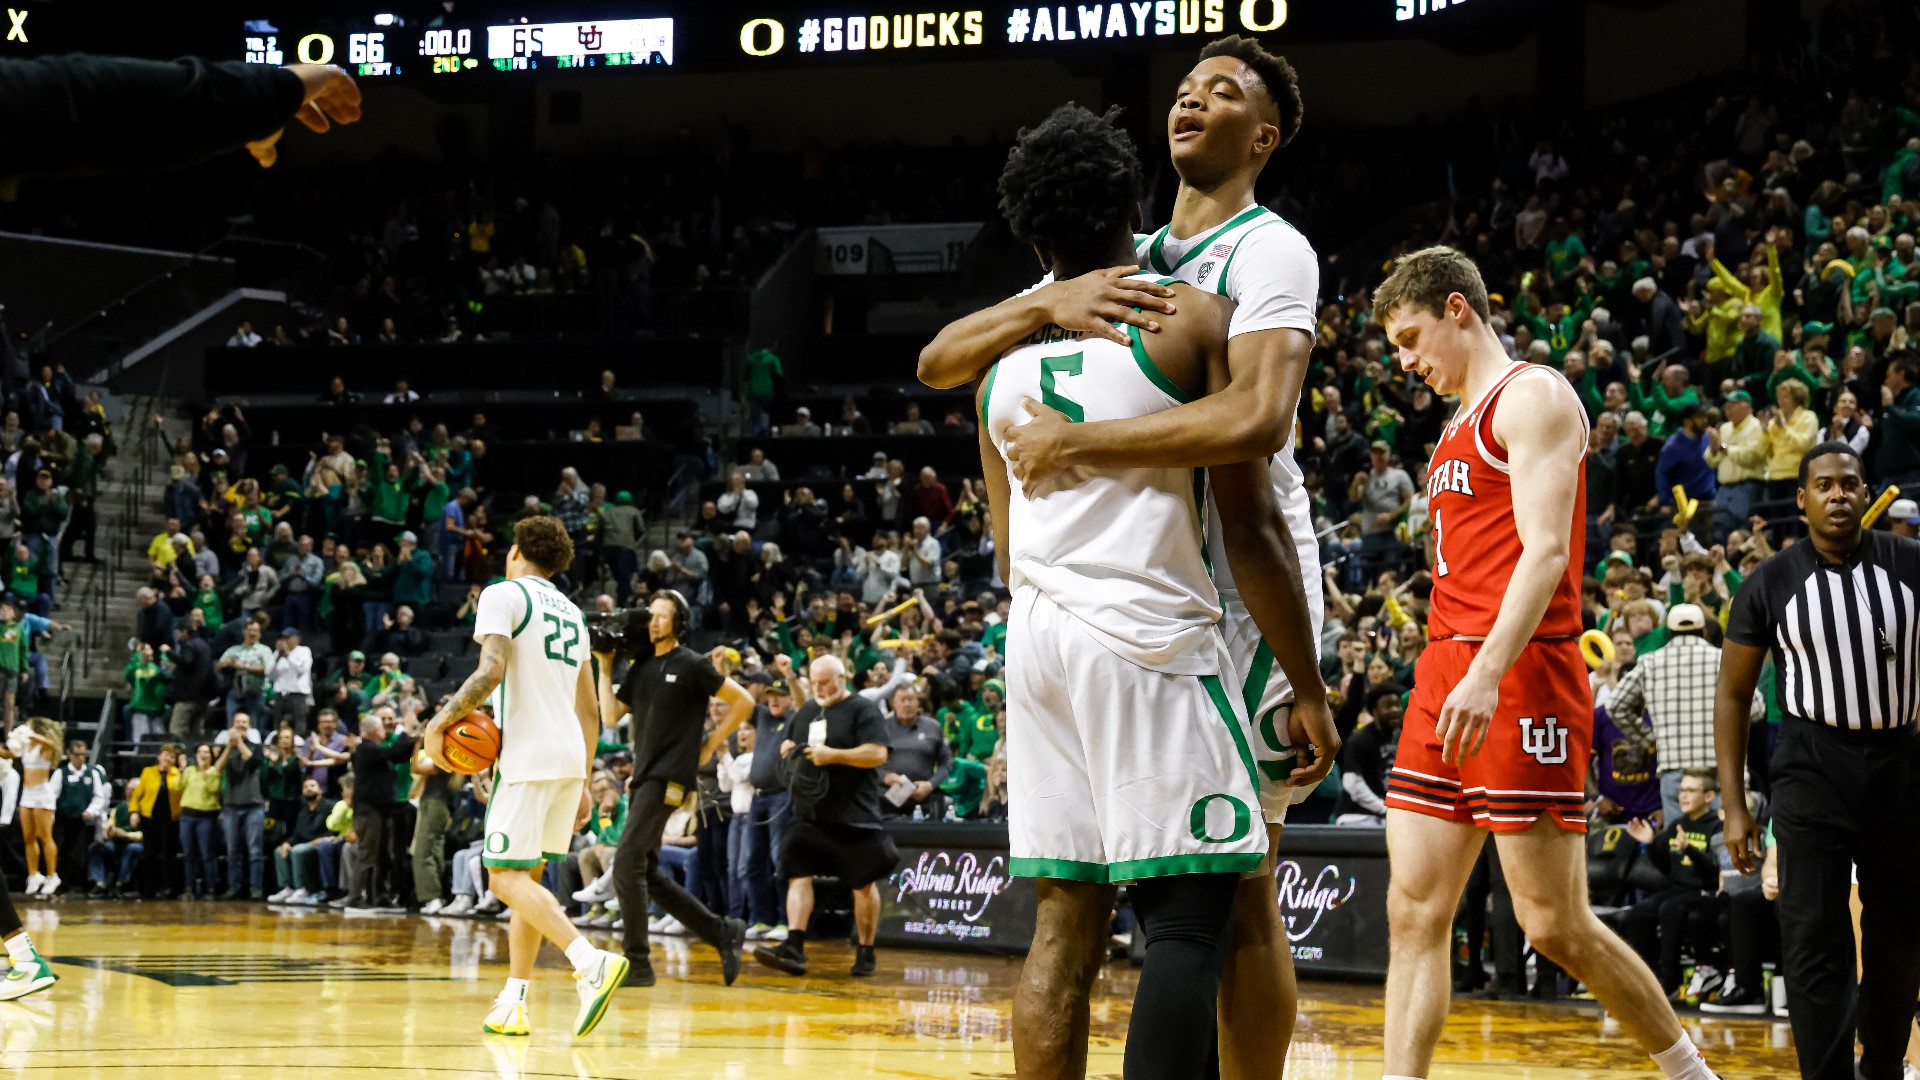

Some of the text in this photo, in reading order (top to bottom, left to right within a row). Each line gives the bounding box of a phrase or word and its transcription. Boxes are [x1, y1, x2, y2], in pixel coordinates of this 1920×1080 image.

[7, 8, 28, 43] X
[513, 28, 543, 57] 65
[798, 11, 983, 52] #GODUCKS
[1007, 0, 1224, 43] #ALWAYSUS
[349, 33, 384, 63] 66
[433, 56, 460, 73] 2ND
[824, 244, 864, 263] 109
[1040, 351, 1084, 422] 5
[1435, 508, 1449, 577] 1
[543, 612, 580, 667] 22
[1190, 793, 1251, 843] O
[955, 853, 1013, 922] Ridge
[1274, 860, 1356, 942] Ridge
